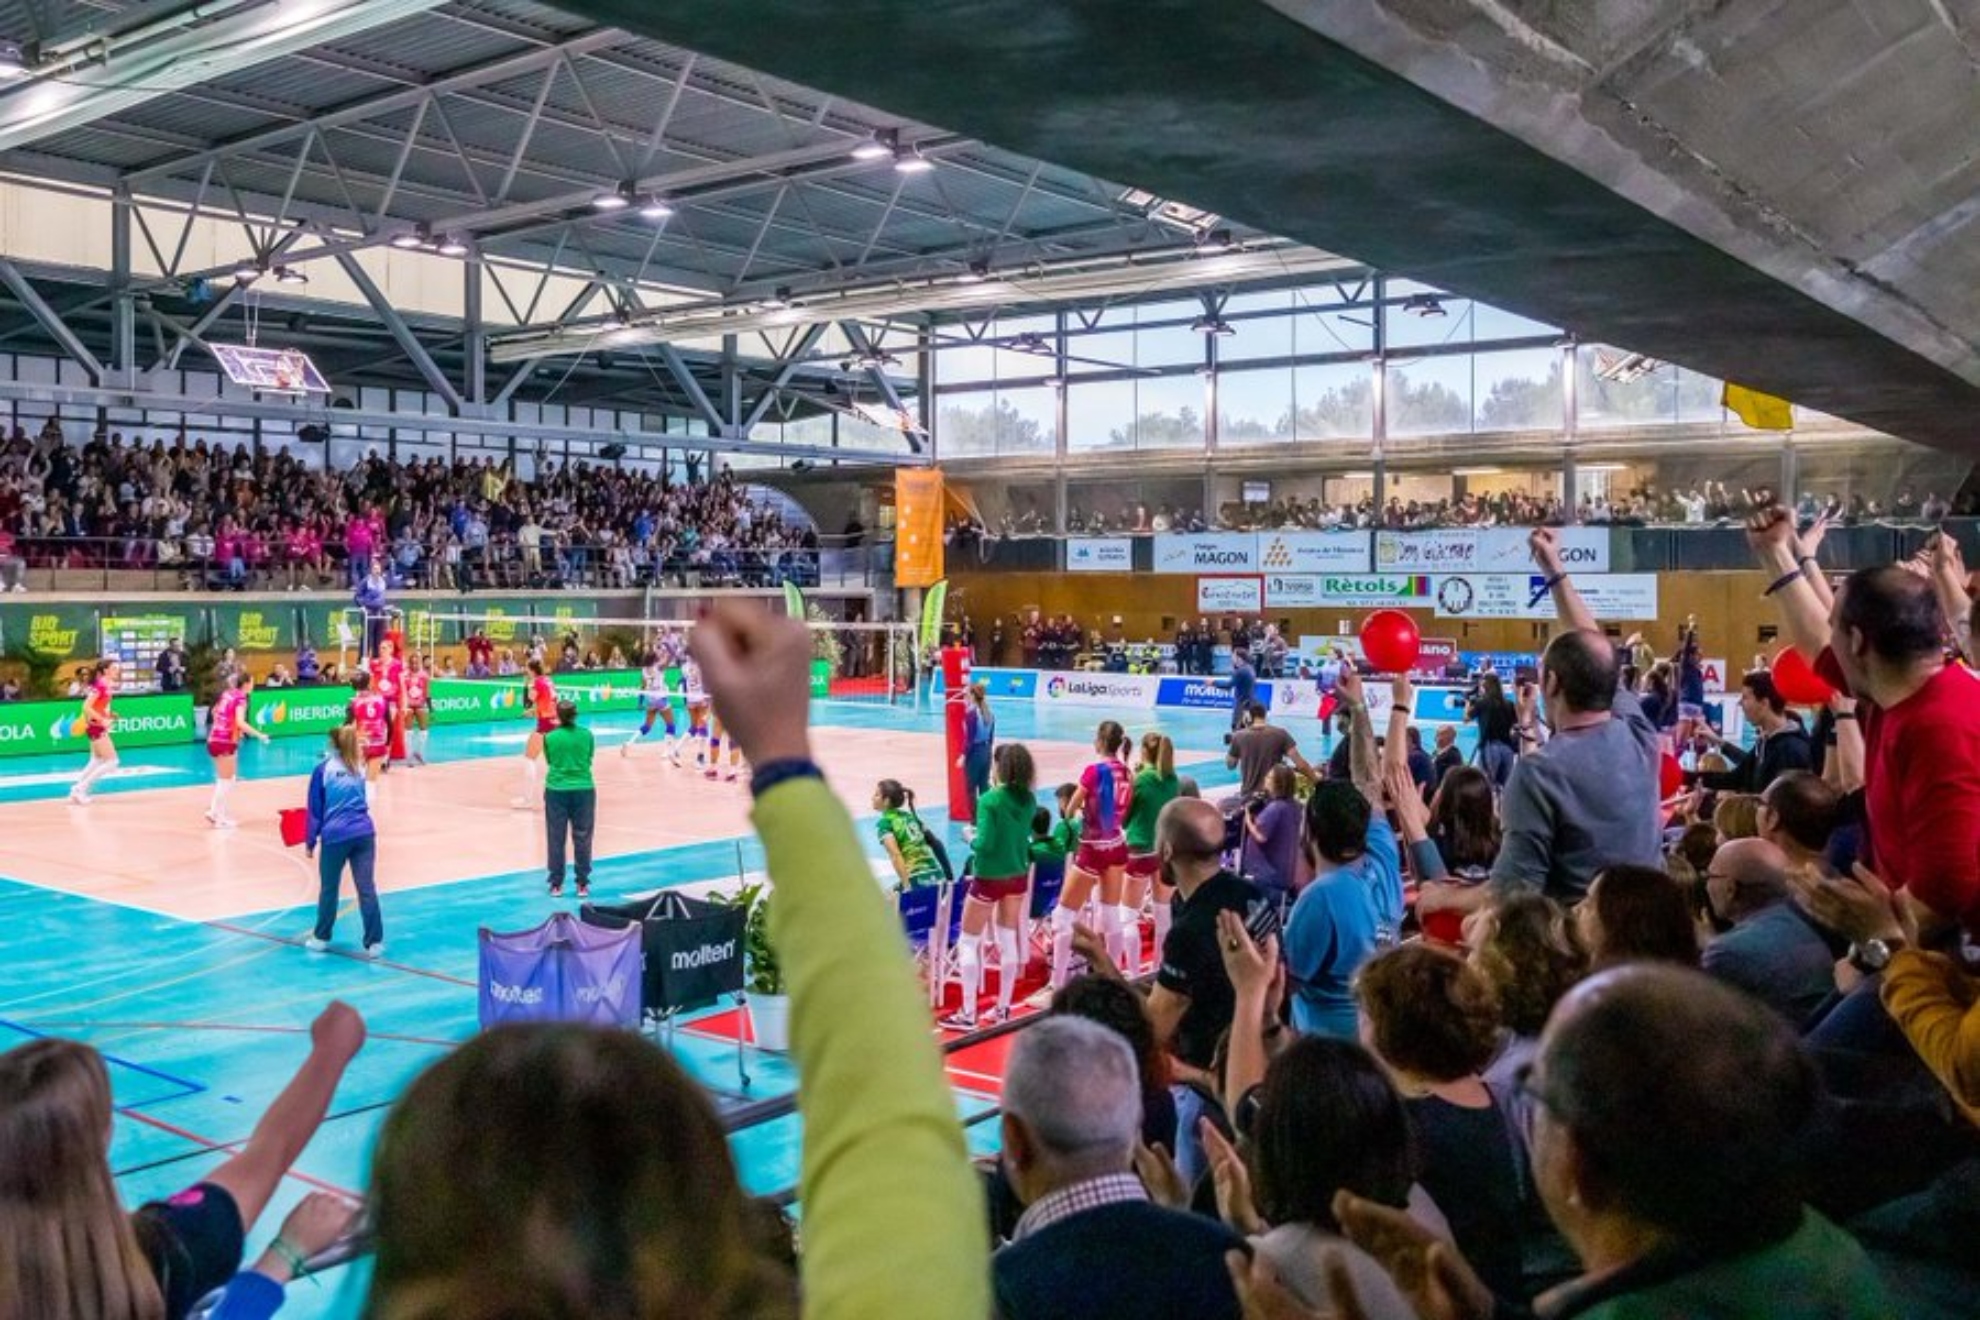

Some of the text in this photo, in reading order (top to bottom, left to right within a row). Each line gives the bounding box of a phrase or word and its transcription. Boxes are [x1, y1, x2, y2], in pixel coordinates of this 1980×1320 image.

[1194, 552, 1248, 565] MAGON
[1326, 578, 1397, 592] Rètols
[1418, 644, 1450, 656] iano
[366, 702, 377, 719] 6
[108, 715, 186, 732] ERDROLA
[1113, 781, 1130, 806] 17
[671, 939, 738, 970] molten
